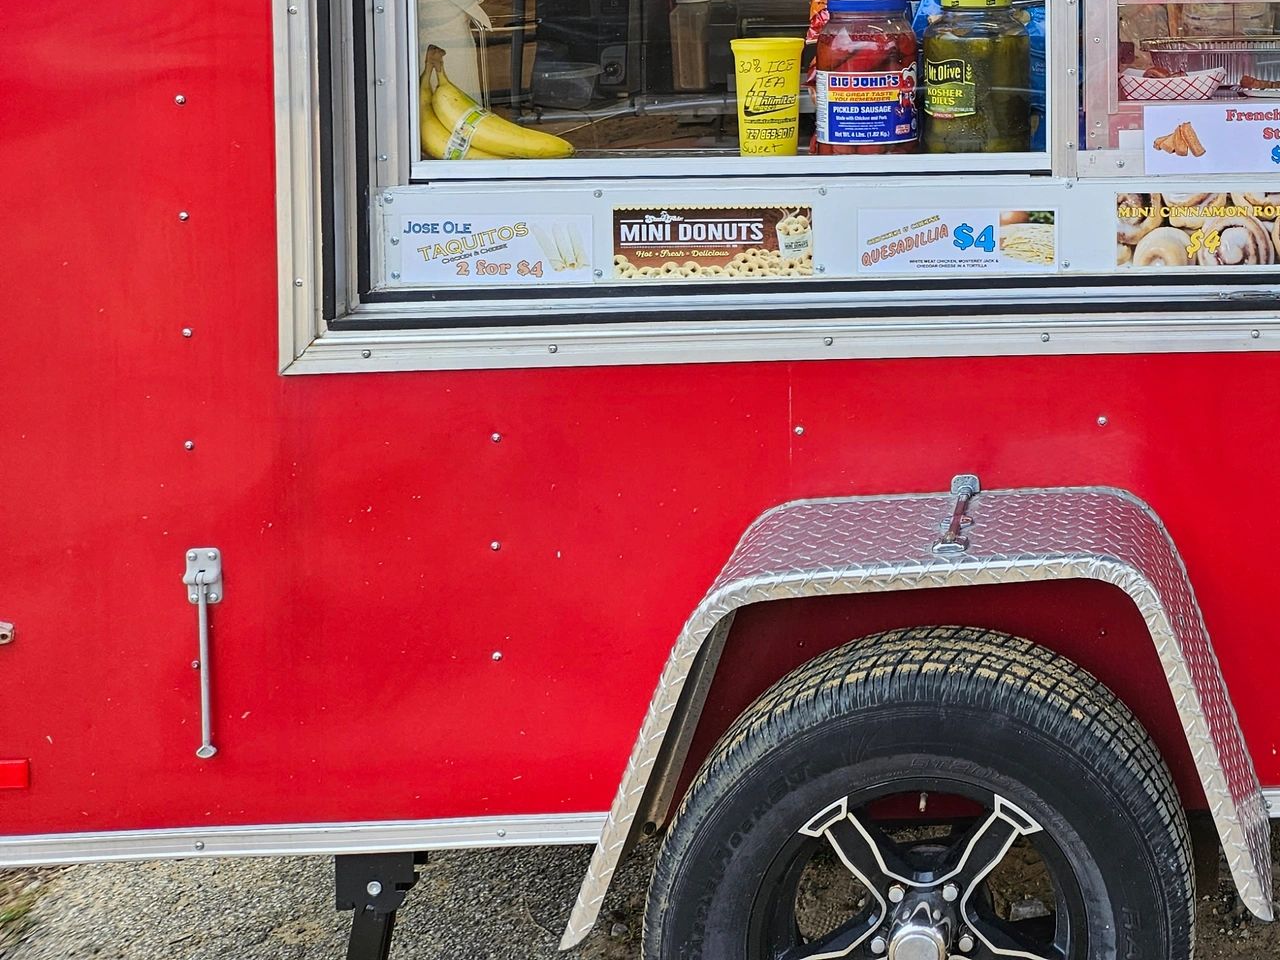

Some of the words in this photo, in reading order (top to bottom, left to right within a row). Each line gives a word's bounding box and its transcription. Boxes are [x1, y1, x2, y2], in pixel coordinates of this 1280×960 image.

[765, 59, 797, 74] ICE
[938, 64, 960, 81] Olive
[757, 75, 785, 88] TEA
[831, 76, 849, 87] BIG
[852, 75, 899, 87] JOHN'S
[928, 87, 963, 97] KOSHER
[932, 97, 955, 105] DILLS
[1117, 206, 1155, 218] MINI
[1159, 205, 1251, 218] CINNAMON
[620, 224, 671, 242] MINI
[679, 223, 764, 241] DONUTS
[417, 222, 529, 262] TAQUITOS
[862, 224, 948, 267] QUESADILLIA
[953, 223, 996, 252] $4
[1186, 229, 1221, 259] $4
[636, 249, 653, 257] Hot
[660, 249, 685, 257] Fresh
[691, 249, 730, 257] Delicious
[456, 261, 469, 276] 2
[476, 260, 511, 276] for
[517, 260, 544, 278] $4
